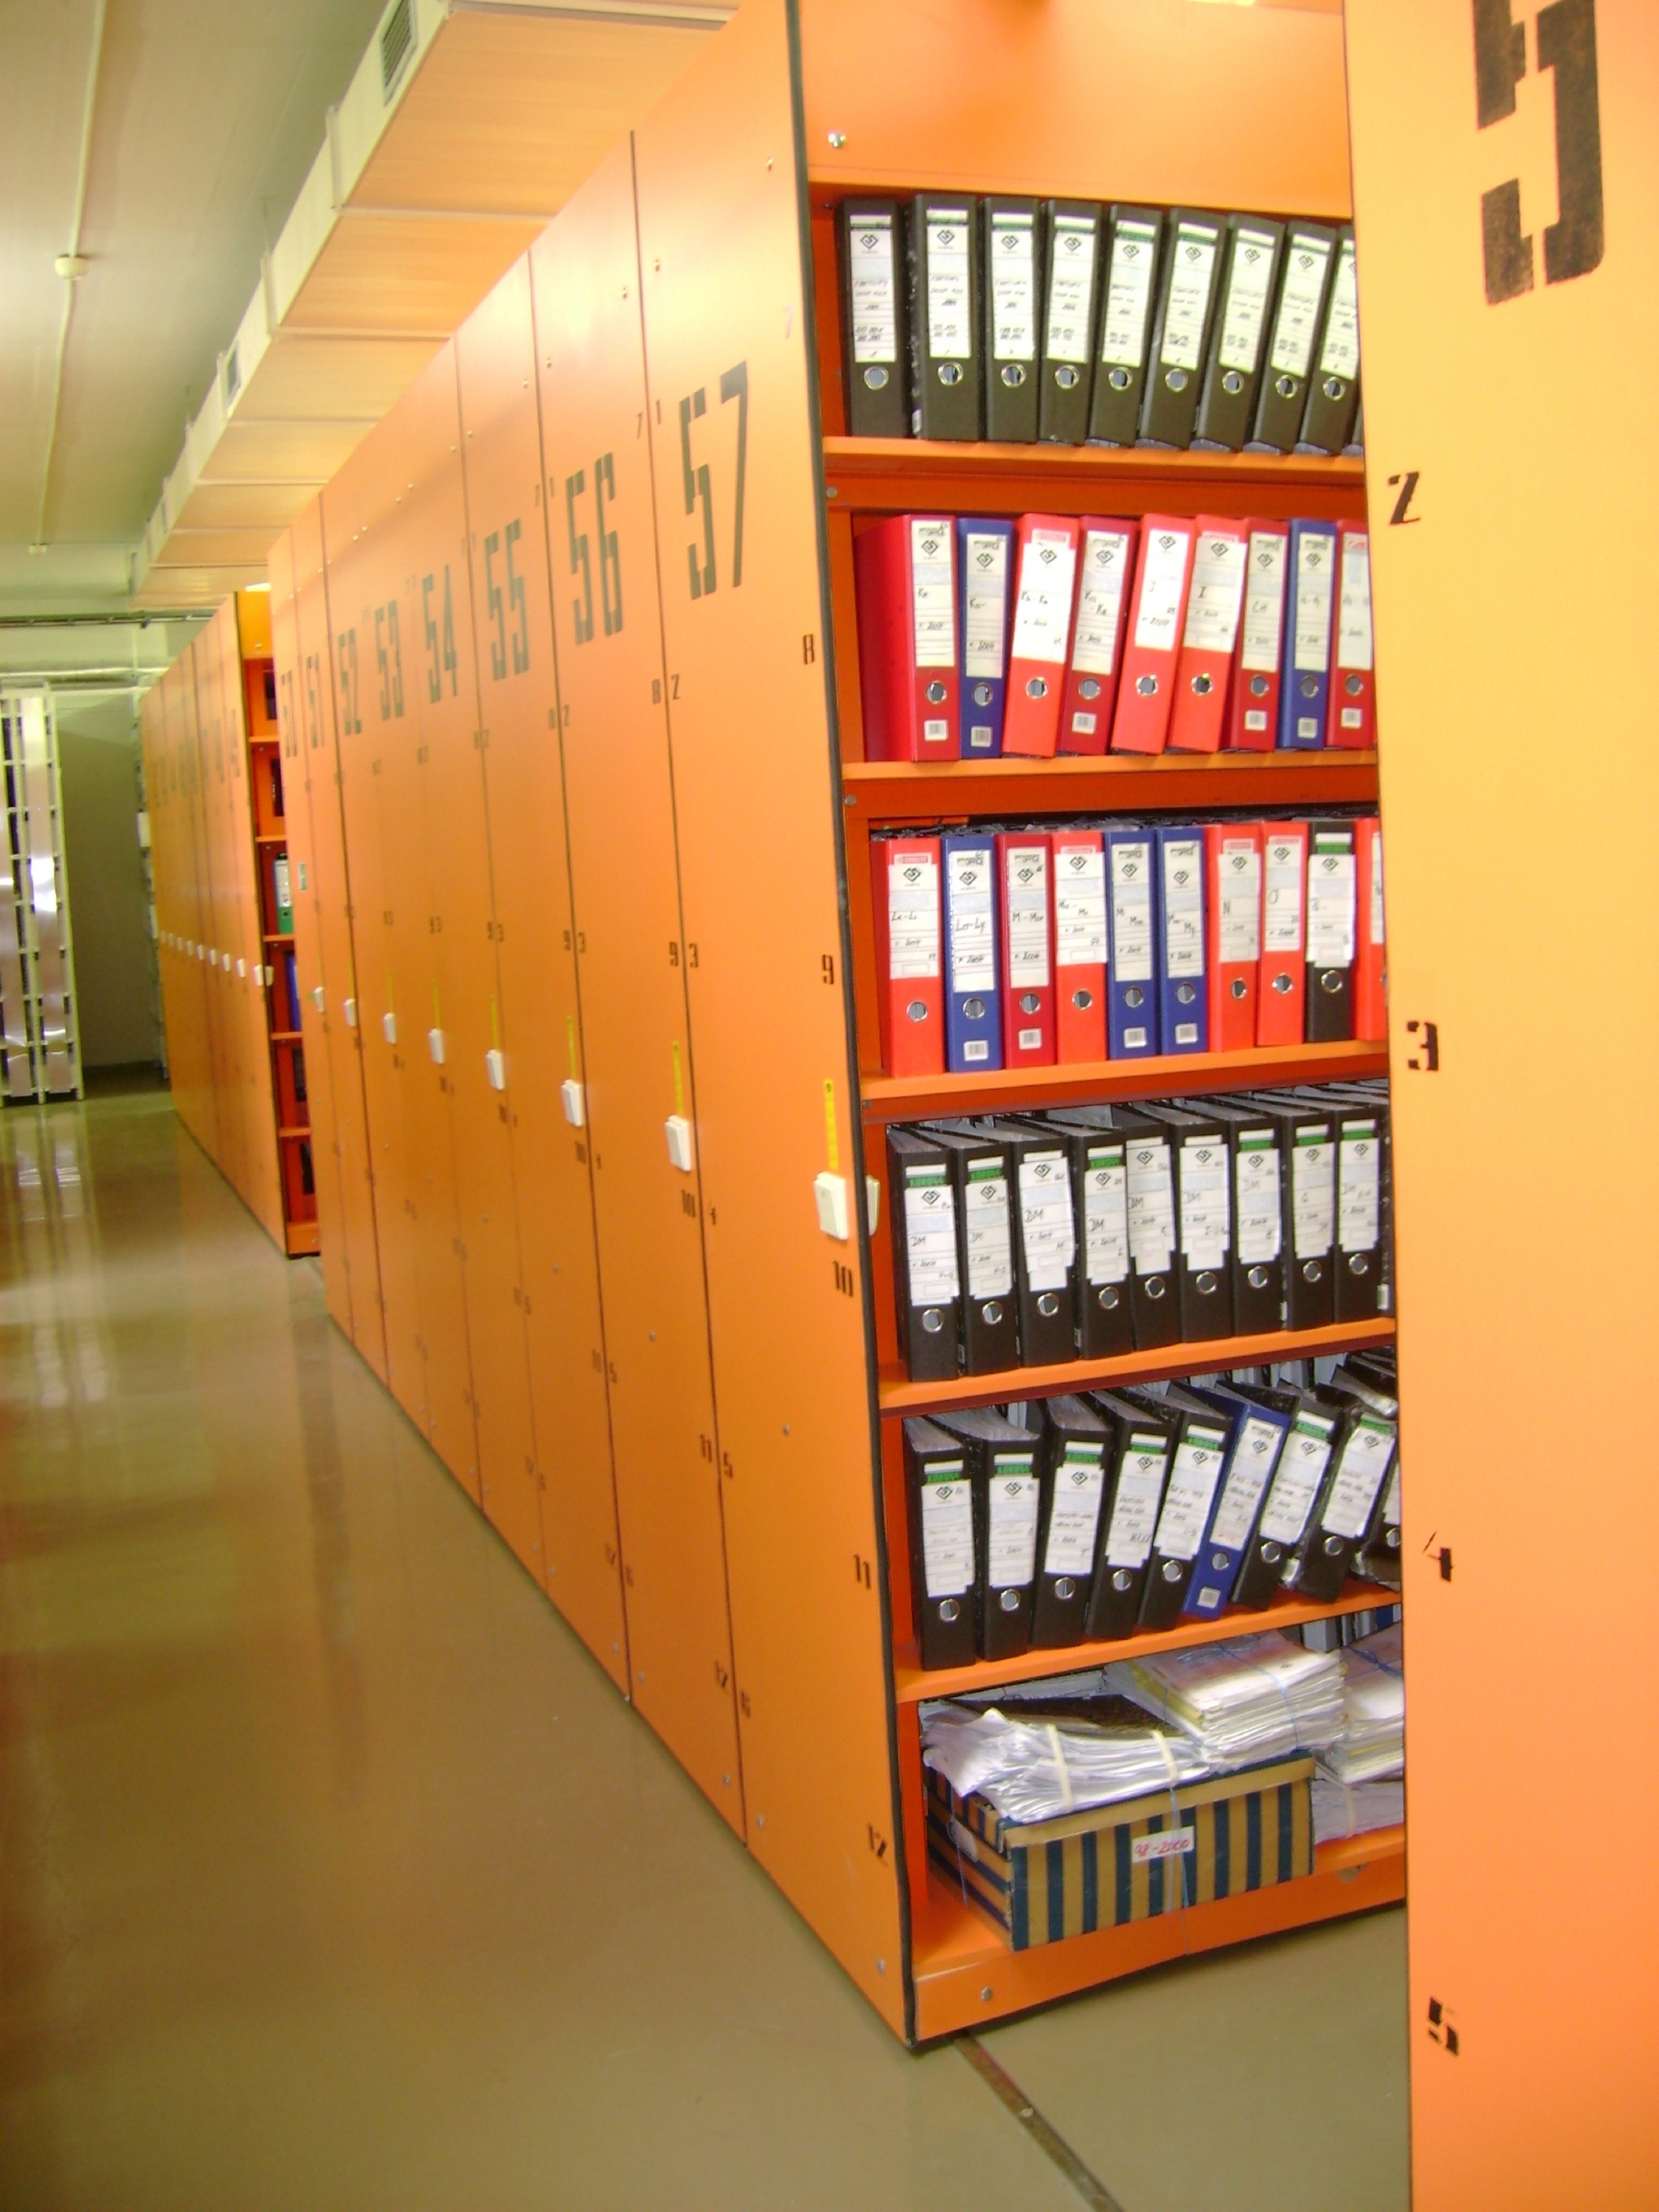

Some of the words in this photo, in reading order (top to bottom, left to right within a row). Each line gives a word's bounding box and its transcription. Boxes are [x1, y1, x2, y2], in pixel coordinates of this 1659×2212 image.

[678, 360, 747, 600] 57
[1388, 471, 1420, 526] 2
[484, 518, 529, 682] 55
[566, 452, 623, 646] 56
[338, 628, 362, 735] 52
[375, 601, 404, 721] 53
[422, 564, 457, 704] 54
[688, 942, 699, 968] 3
[821, 954, 834, 985] 9
[1406, 1020, 1439, 1071] 3
[1024, 1209, 1044, 1223] DM
